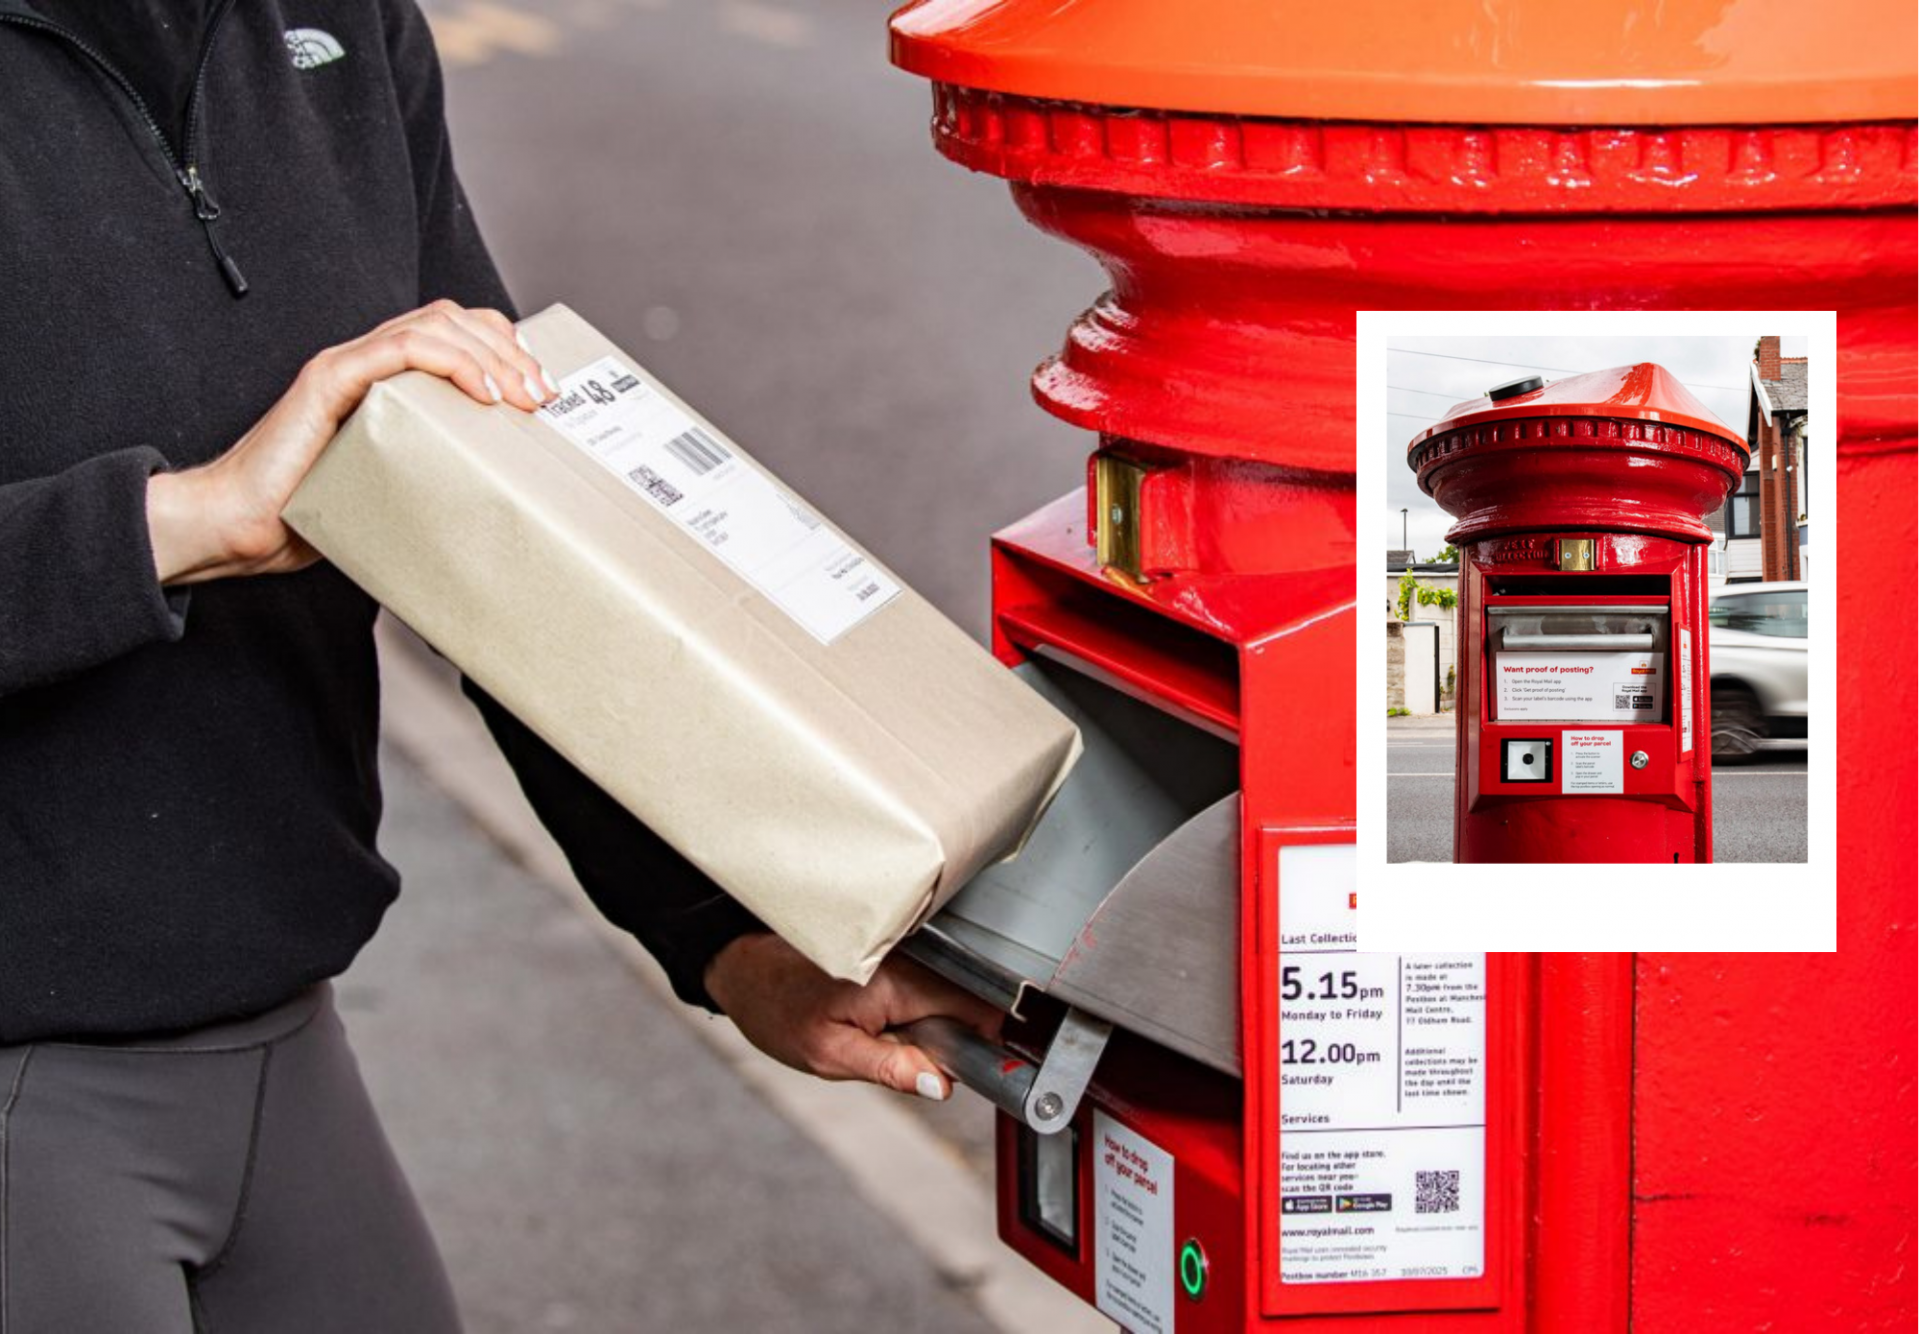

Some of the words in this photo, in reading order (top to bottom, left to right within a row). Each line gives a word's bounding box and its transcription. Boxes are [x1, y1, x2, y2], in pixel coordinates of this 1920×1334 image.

[580, 379, 616, 406] 48
[1525, 666, 1548, 674] proof
[1560, 666, 1594, 675] posting?
[1282, 934, 1306, 945] Last
[1435, 961, 1473, 970] collection
[1281, 966, 1384, 1002] 5.15pm
[1406, 983, 1440, 993] 7.30pm
[1405, 995, 1436, 1003] Postbox
[1282, 1010, 1327, 1022] Monday
[1330, 1010, 1342, 1020] to
[1347, 1008, 1383, 1021] Friday
[1405, 1006, 1423, 1014] Mail
[1281, 1039, 1381, 1066] 12.00pm
[1405, 1048, 1446, 1056] Additional
[1405, 1058, 1447, 1066] collections
[1449, 1058, 1466, 1066] may
[1405, 1069, 1427, 1077] made
[1429, 1067, 1473, 1076] throughout
[1281, 1074, 1334, 1086] Saturday
[1420, 1079, 1435, 1088] day
[1437, 1078, 1456, 1086] until
[1422, 1089, 1440, 1097] time
[1281, 1113, 1331, 1125] Services
[1104, 1133, 1120, 1153] How
[1121, 1144, 1130, 1160] to
[1130, 1150, 1148, 1174] drop
[1282, 1151, 1299, 1160] Find
[1301, 1152, 1312, 1160] us
[1327, 1151, 1341, 1159] the
[1343, 1151, 1360, 1161] app
[1282, 1162, 1295, 1171] For
[1297, 1162, 1331, 1171] locating
[1333, 1161, 1356, 1170] other
[1104, 1152, 1116, 1168] off
[1116, 1161, 1134, 1179] your
[1134, 1172, 1158, 1196] parcel
[1282, 1173, 1315, 1182] services
[1317, 1173, 1337, 1181] near
[1282, 1184, 1300, 1193] scan
[1302, 1183, 1317, 1192] the
[1318, 1183, 1331, 1192] QR
[1333, 1182, 1354, 1191] code
[1296, 1202, 1310, 1212] App
[1310, 1201, 1329, 1210] Store
[1352, 1201, 1375, 1210] Google
[1375, 1200, 1389, 1209] Play
[1281, 1226, 1375, 1239] www.royalmail.com
[1282, 1270, 1313, 1280] Postbox
[1315, 1269, 1348, 1280] number
